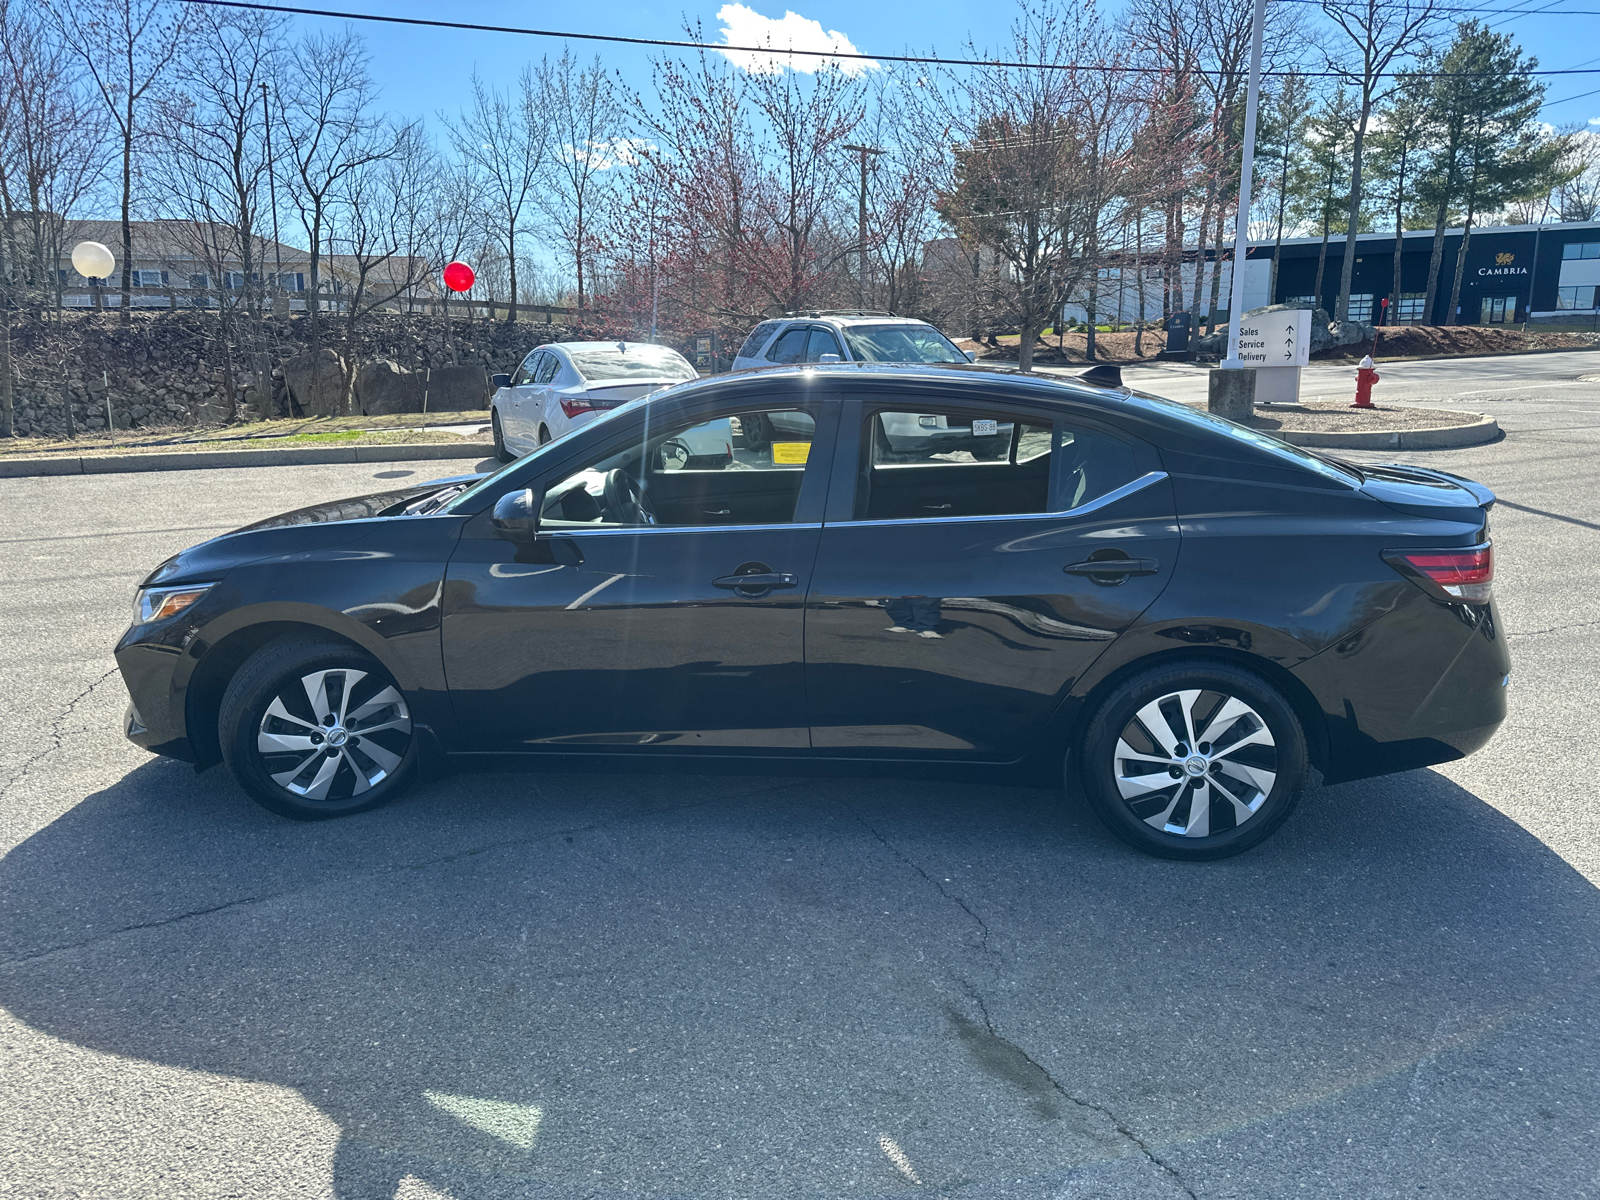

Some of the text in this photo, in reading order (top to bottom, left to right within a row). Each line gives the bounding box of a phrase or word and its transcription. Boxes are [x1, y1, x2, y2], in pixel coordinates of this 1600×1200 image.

[1478, 267, 1527, 275] CAMBRIA
[1239, 327, 1258, 336] Sales
[1238, 340, 1264, 348] Service
[1238, 352, 1266, 362] Delivery
